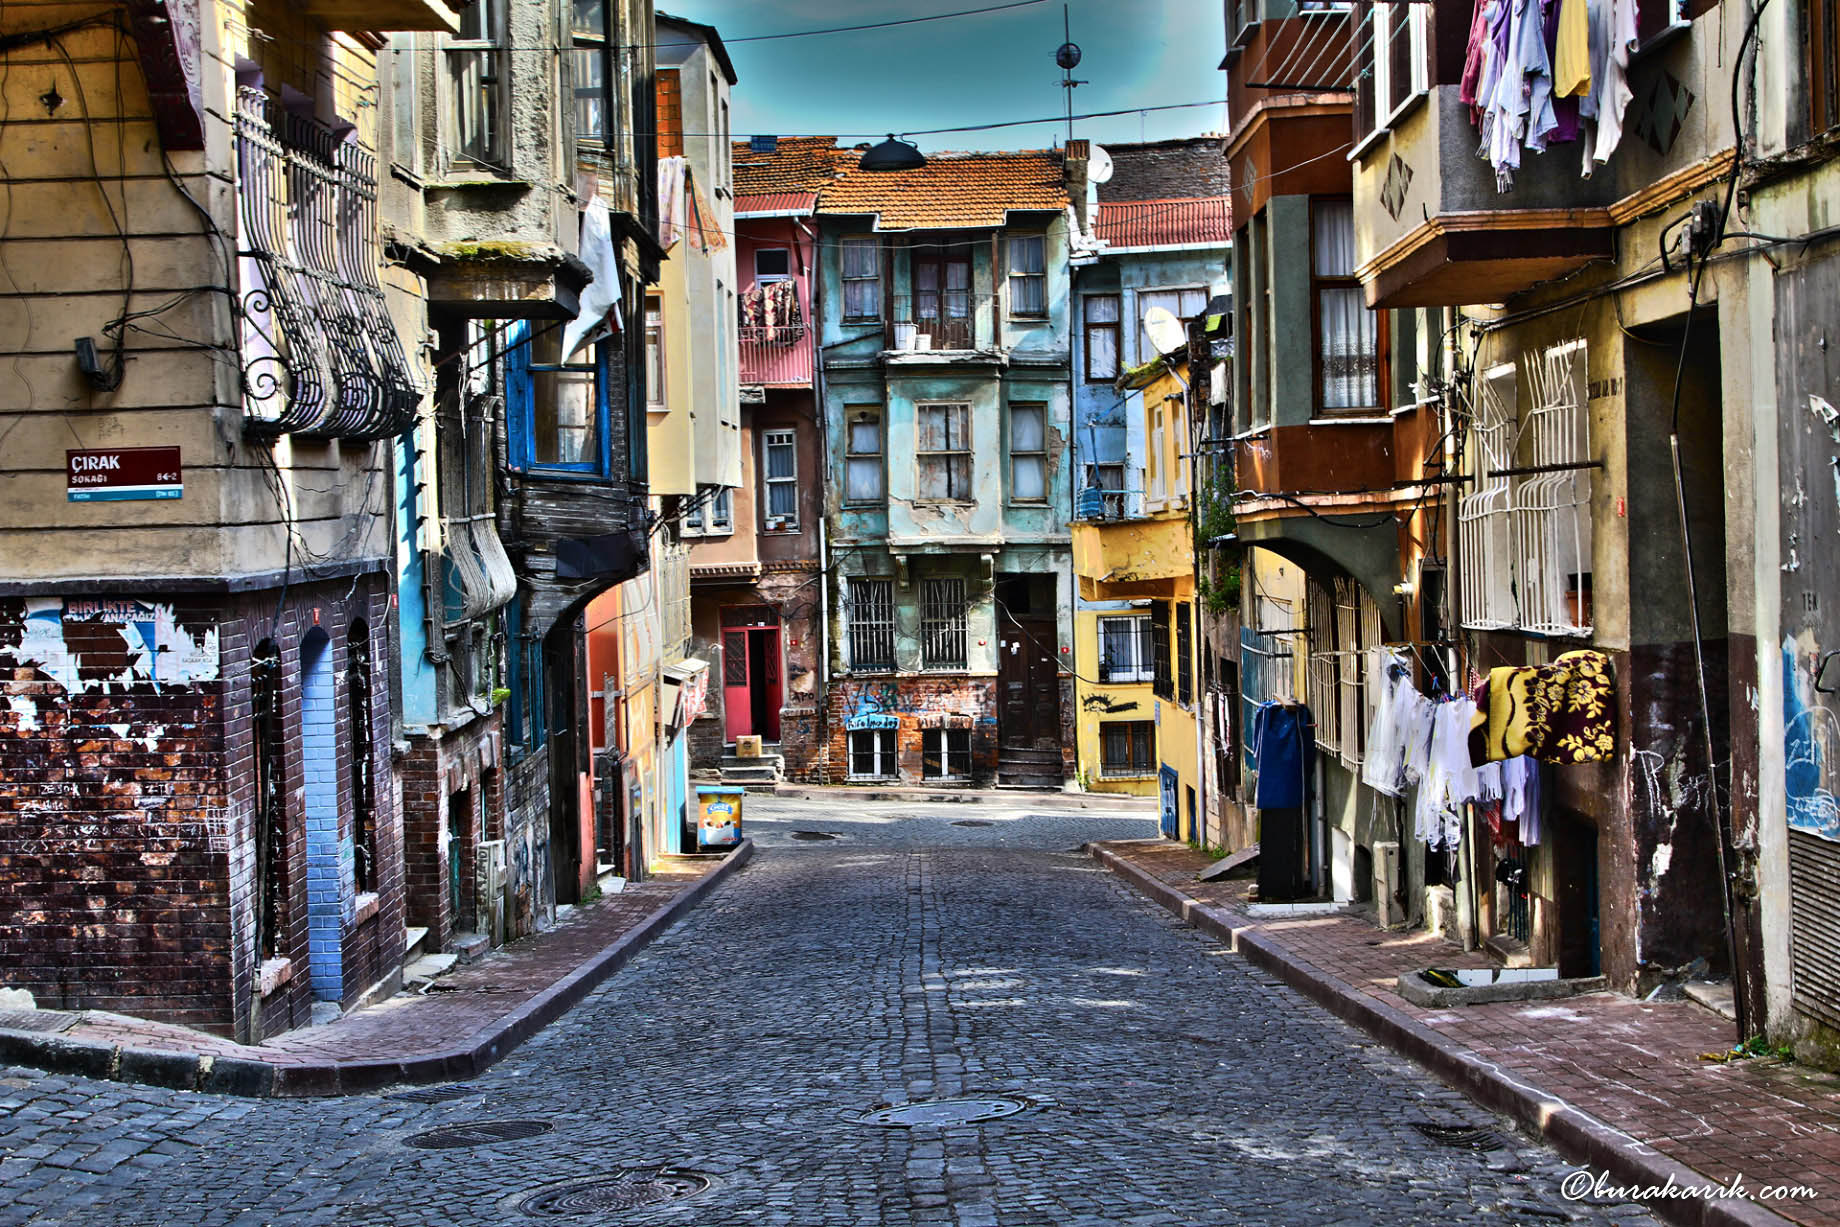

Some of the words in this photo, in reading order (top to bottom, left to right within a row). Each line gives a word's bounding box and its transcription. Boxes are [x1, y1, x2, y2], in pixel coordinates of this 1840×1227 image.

[71, 455, 120, 473] ÇIRAK
[71, 474, 107, 484] SOKAĞI
[68, 600, 137, 615] BİRLİKTE
